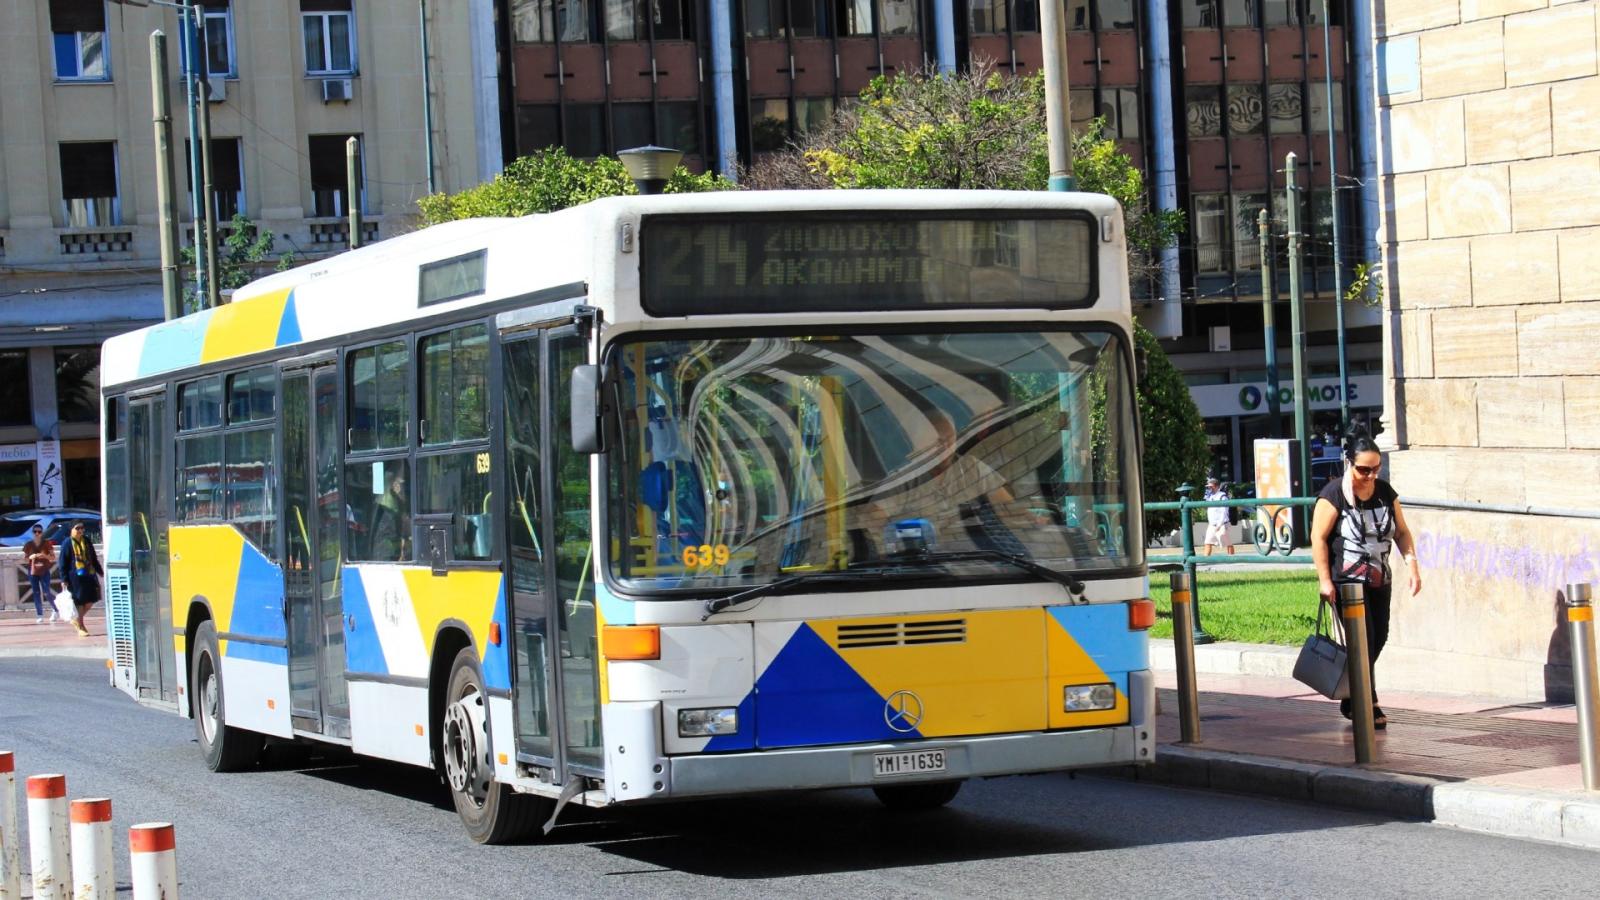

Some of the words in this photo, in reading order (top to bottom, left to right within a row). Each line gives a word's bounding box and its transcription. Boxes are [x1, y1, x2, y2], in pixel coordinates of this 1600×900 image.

[661, 226, 747, 287] 214
[477, 452, 490, 474] 639
[683, 544, 730, 568] 639
